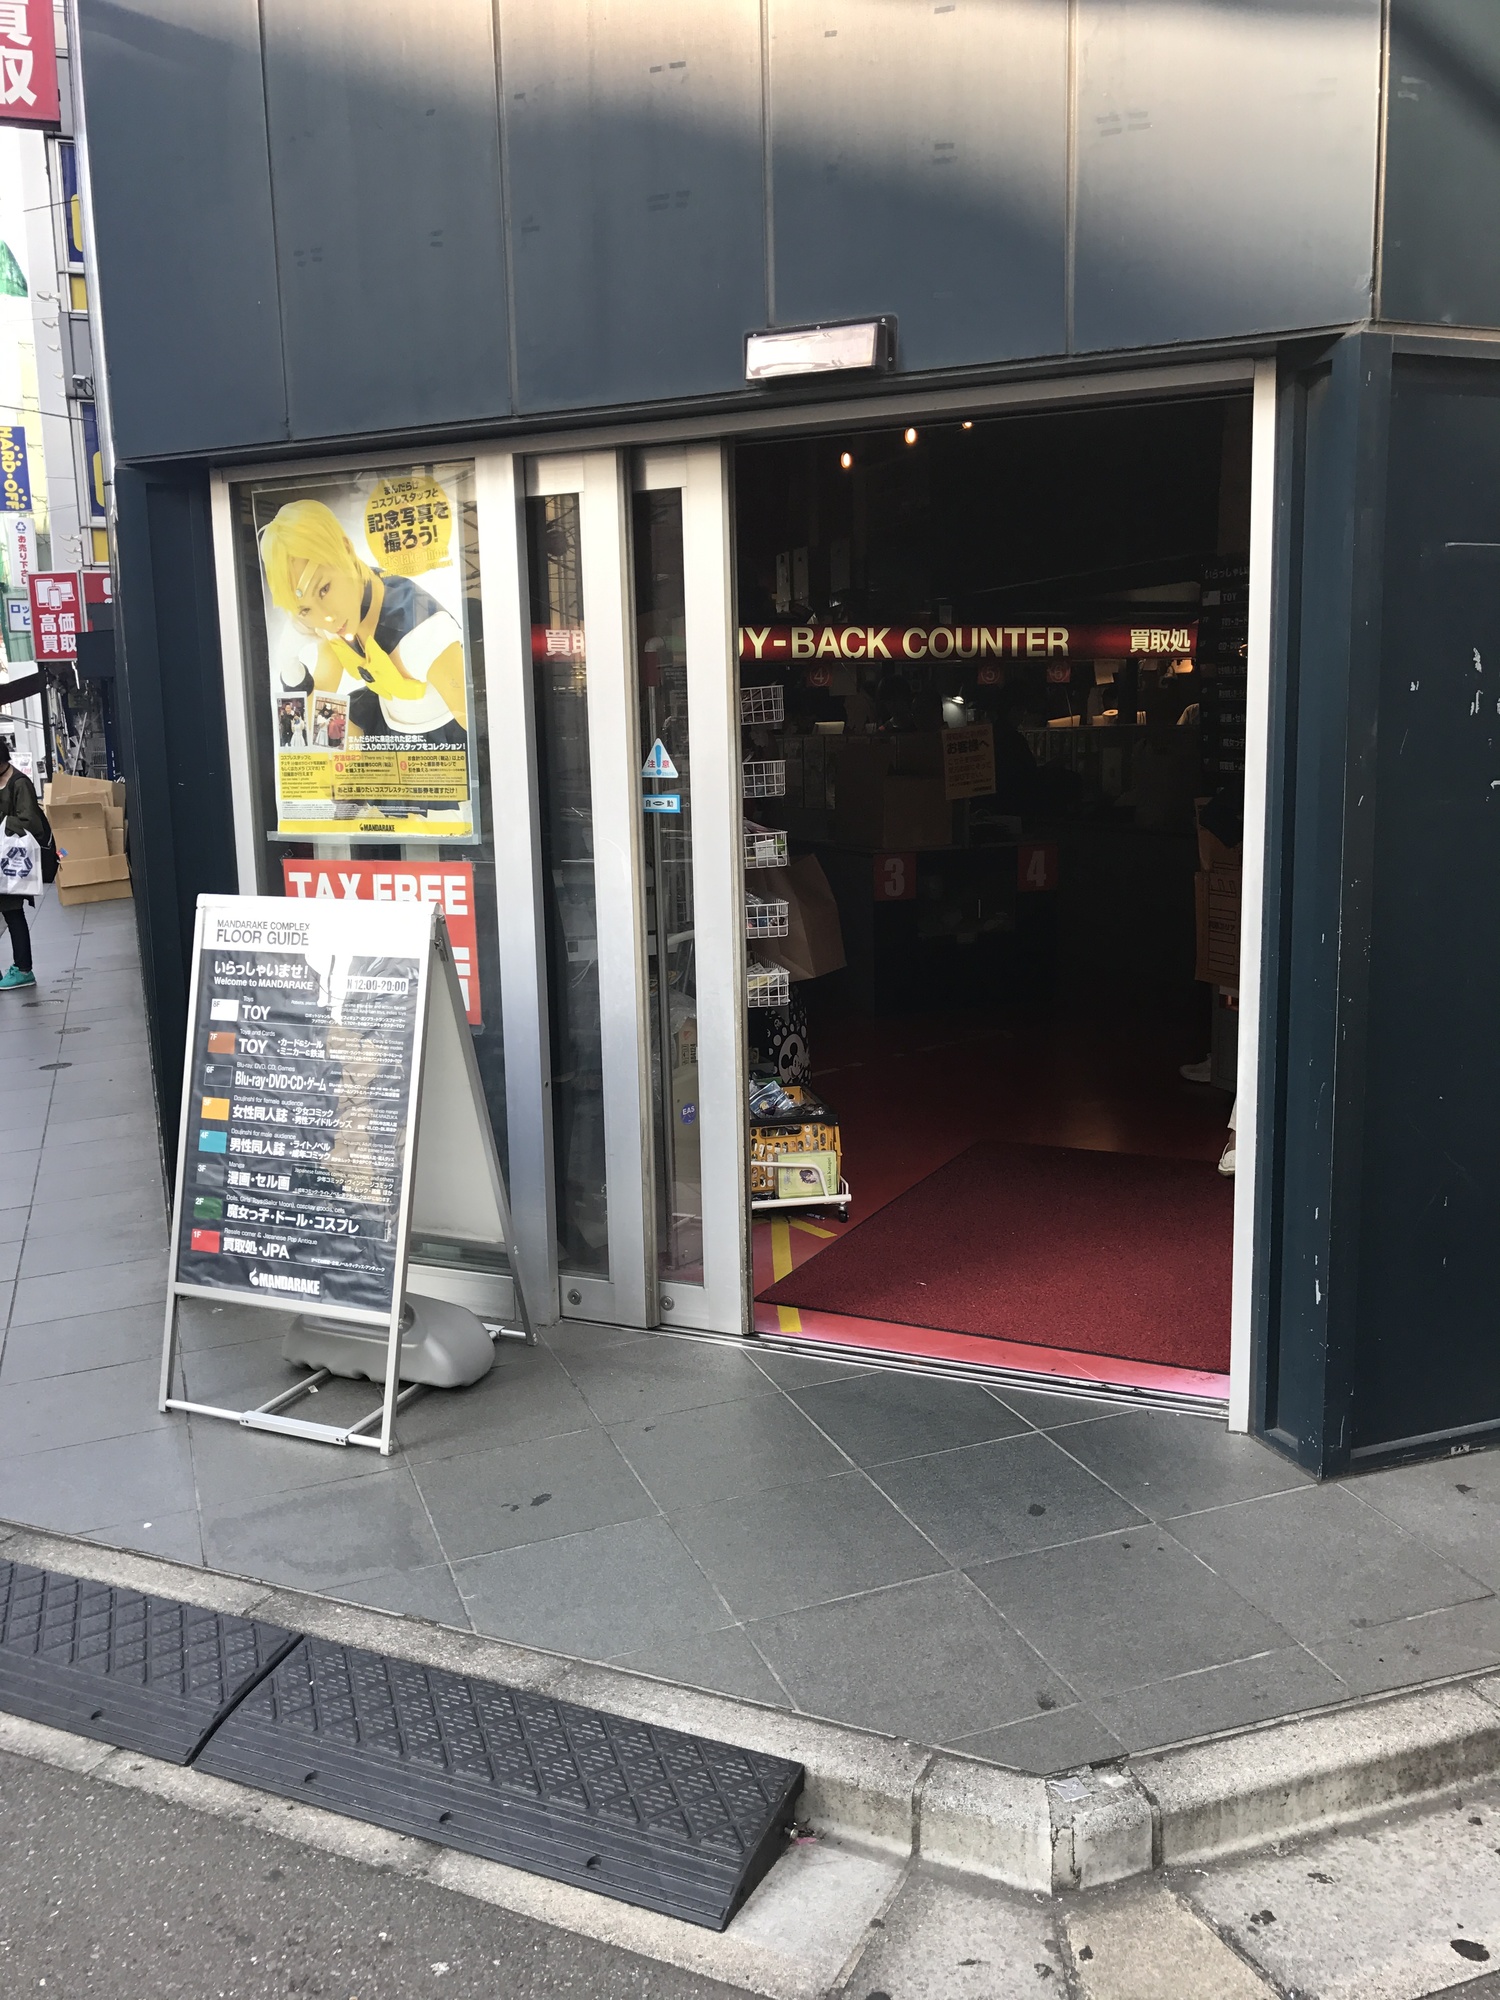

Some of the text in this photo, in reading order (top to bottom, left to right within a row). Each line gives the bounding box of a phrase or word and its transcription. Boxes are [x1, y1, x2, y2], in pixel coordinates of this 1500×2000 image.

[371, 488, 439, 509] コスプレスタッフと
[367, 501, 449, 534] 記念写真を
[39, 613, 75, 633] 高価
[42, 634, 77, 653] 買取
[902, 626, 1070, 659] COUNTER
[1130, 628, 1190, 653] 買取処
[946, 739, 990, 754] お客様へ
[364, 824, 395, 832] MANDARAKE
[885, 858, 905, 897] 3
[1026, 850, 1046, 886] 4
[288, 872, 361, 900] TAX
[217, 919, 310, 931] MANDARAKE COMPLEX
[217, 928, 309, 946] FLOOR GUIDE
[214, 960, 309, 979] いらっしゃいませ!
[214, 976, 314, 990] Welcome to MANDARAKE
[355, 979, 406, 992] 12:00-20:00
[242, 1004, 271, 1020] TOY
[210, 1033, 268, 1054] 7F TOY
[206, 1066, 214, 1074] 6F
[233, 1095, 255, 1103] Doujinshi
[232, 1103, 288, 1123] 女性同人誌
[682, 1106, 695, 1115] EAS
[200, 1131, 209, 1139] 4F
[231, 1128, 252, 1136] Doujinshi
[229, 1137, 286, 1157] 男性同人誌
[197, 1161, 245, 1172] 3F Manga
[227, 1170, 291, 1191] 漫画・セル画
[195, 1197, 204, 1206] 2F
[226, 1203, 360, 1234] 魔女っ子・ドール・コスプレ
[193, 1231, 202, 1239] 1F
[223, 1237, 290, 1260] 買取処・JPA
[259, 1272, 320, 1295] MANDARAKE
